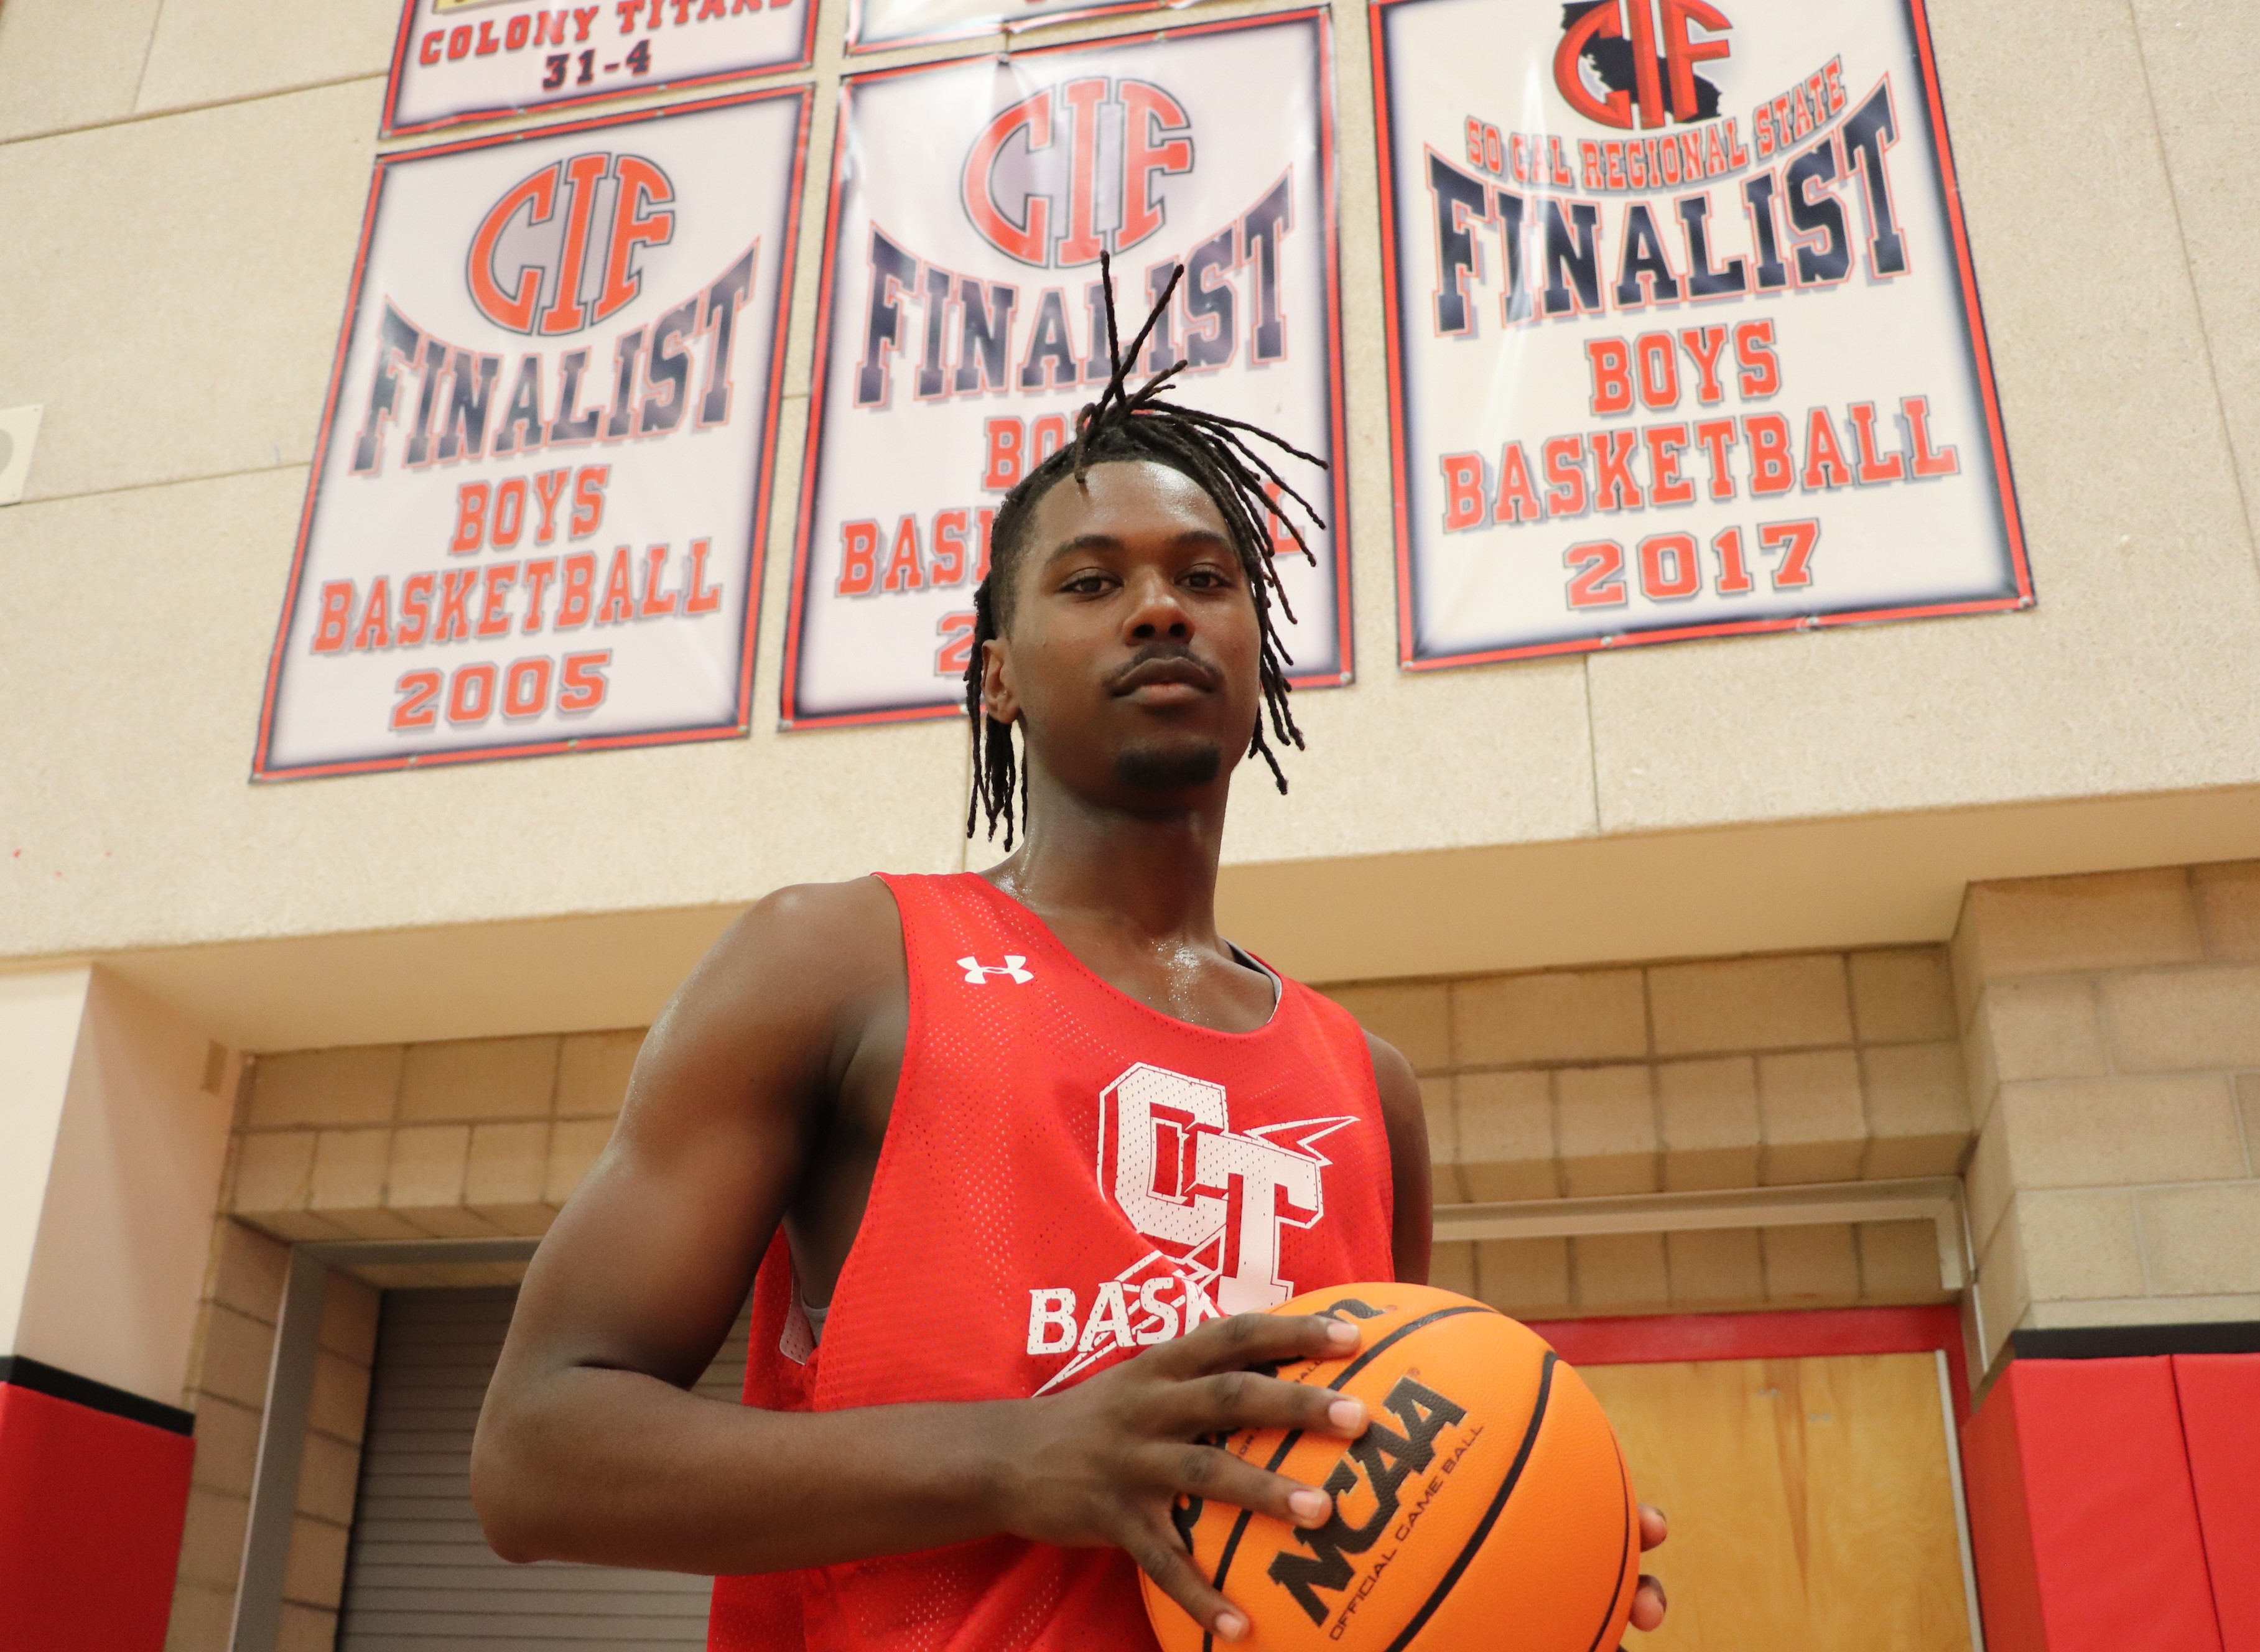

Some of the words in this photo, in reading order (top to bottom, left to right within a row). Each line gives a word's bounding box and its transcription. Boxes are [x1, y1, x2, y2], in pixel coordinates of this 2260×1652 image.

[419, 6, 598, 66] COLONY
[616, 0, 794, 34] TITA
[542, 39, 651, 91] 31-4
[1553, 0, 1733, 130] CIF
[961, 77, 1194, 269] CIF
[1465, 115, 1502, 174] SO
[1510, 132, 1572, 188] CAL
[1577, 117, 1749, 190] REGIONAL
[1752, 54, 1848, 159] STATE
[467, 152, 676, 336] CIF
[1423, 72, 1910, 337] FINALIST
[854, 162, 1295, 407] FINALIST
[349, 235, 761, 477] FINALIST
[1585, 318, 1781, 416] BOYS
[449, 463, 612, 555] BOYS
[1439, 395, 1960, 533] BASKETBALL
[309, 537, 723, 654] BASKETBALL
[1563, 517, 1820, 610] 2017
[388, 649, 613, 731] 2005
[1267, 1375, 1467, 1627] NCAA
[1329, 1549, 1397, 1641] OFFICIAL
[1394, 1475, 1444, 1542] GAME
[1441, 1426, 1484, 1474] BALL
